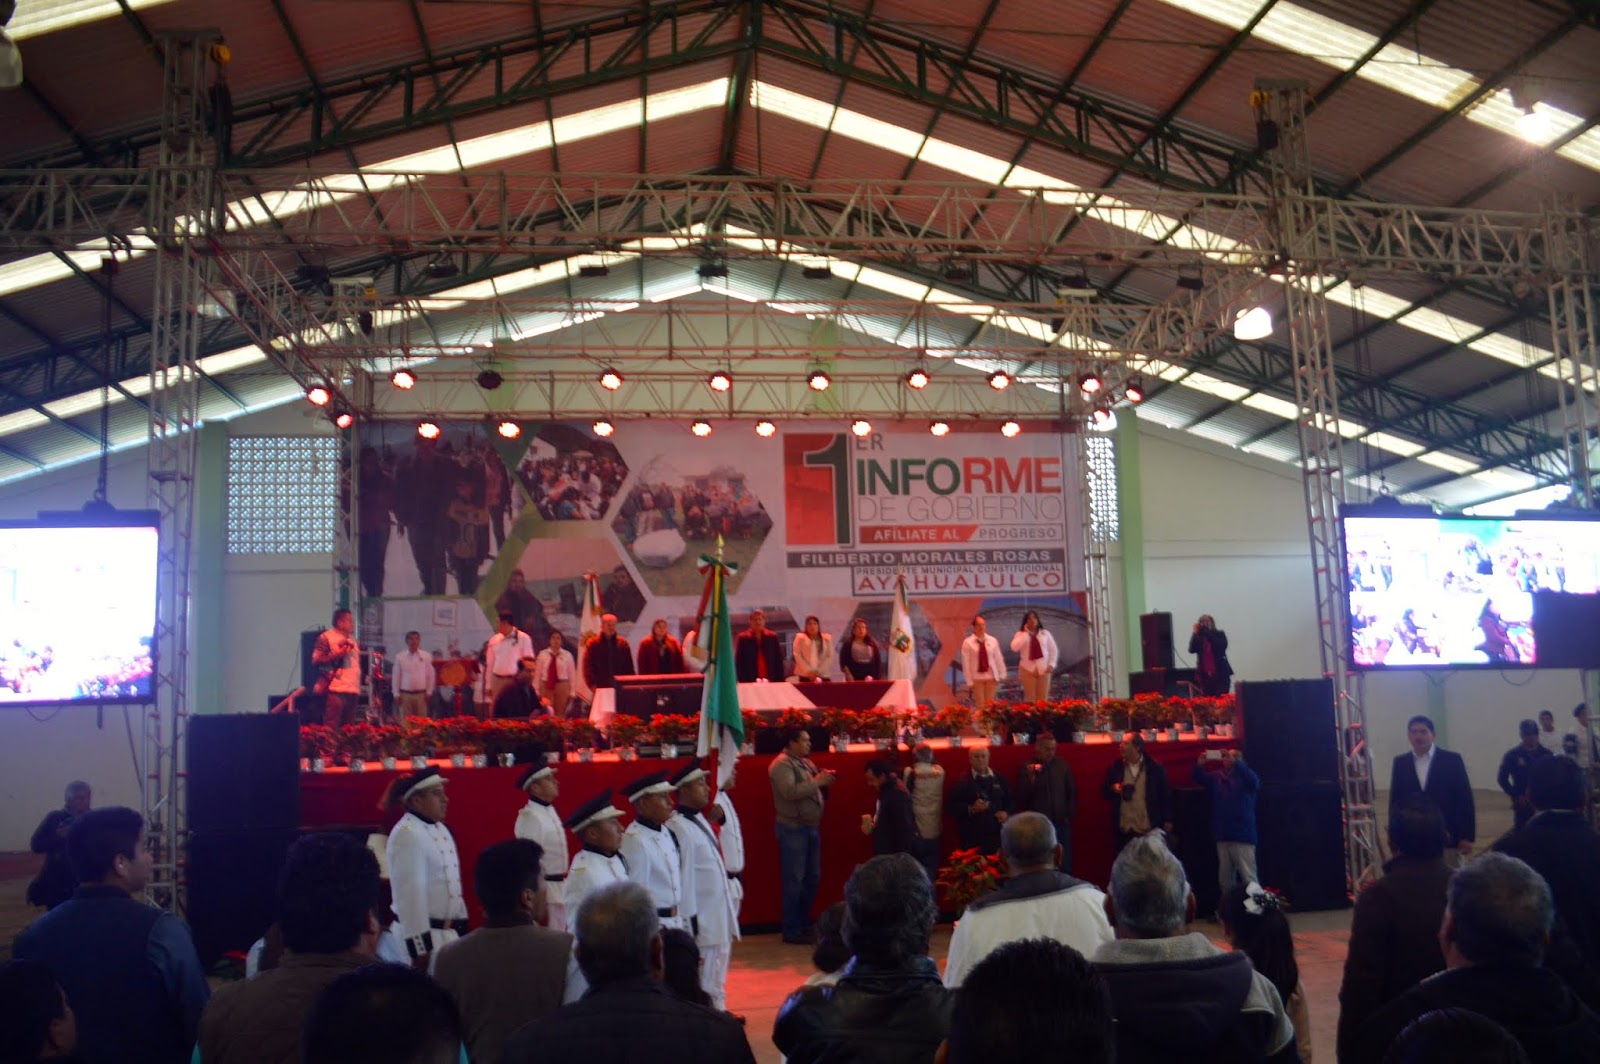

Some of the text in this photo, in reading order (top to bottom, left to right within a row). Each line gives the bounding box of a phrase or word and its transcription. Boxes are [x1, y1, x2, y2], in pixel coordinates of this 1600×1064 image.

[857, 457, 1061, 495] INFORME
[804, 432, 850, 545] 1
[858, 495, 1062, 521] DE GOBIERNO
[942, 529, 960, 540] AL
[978, 527, 1056, 539] PROGRESO
[800, 549, 1051, 565] FILIBERTO MORALES ROSAS
[856, 563, 1060, 575] PRESIDETE MUNICIPAL CONSTITUCIONAL
